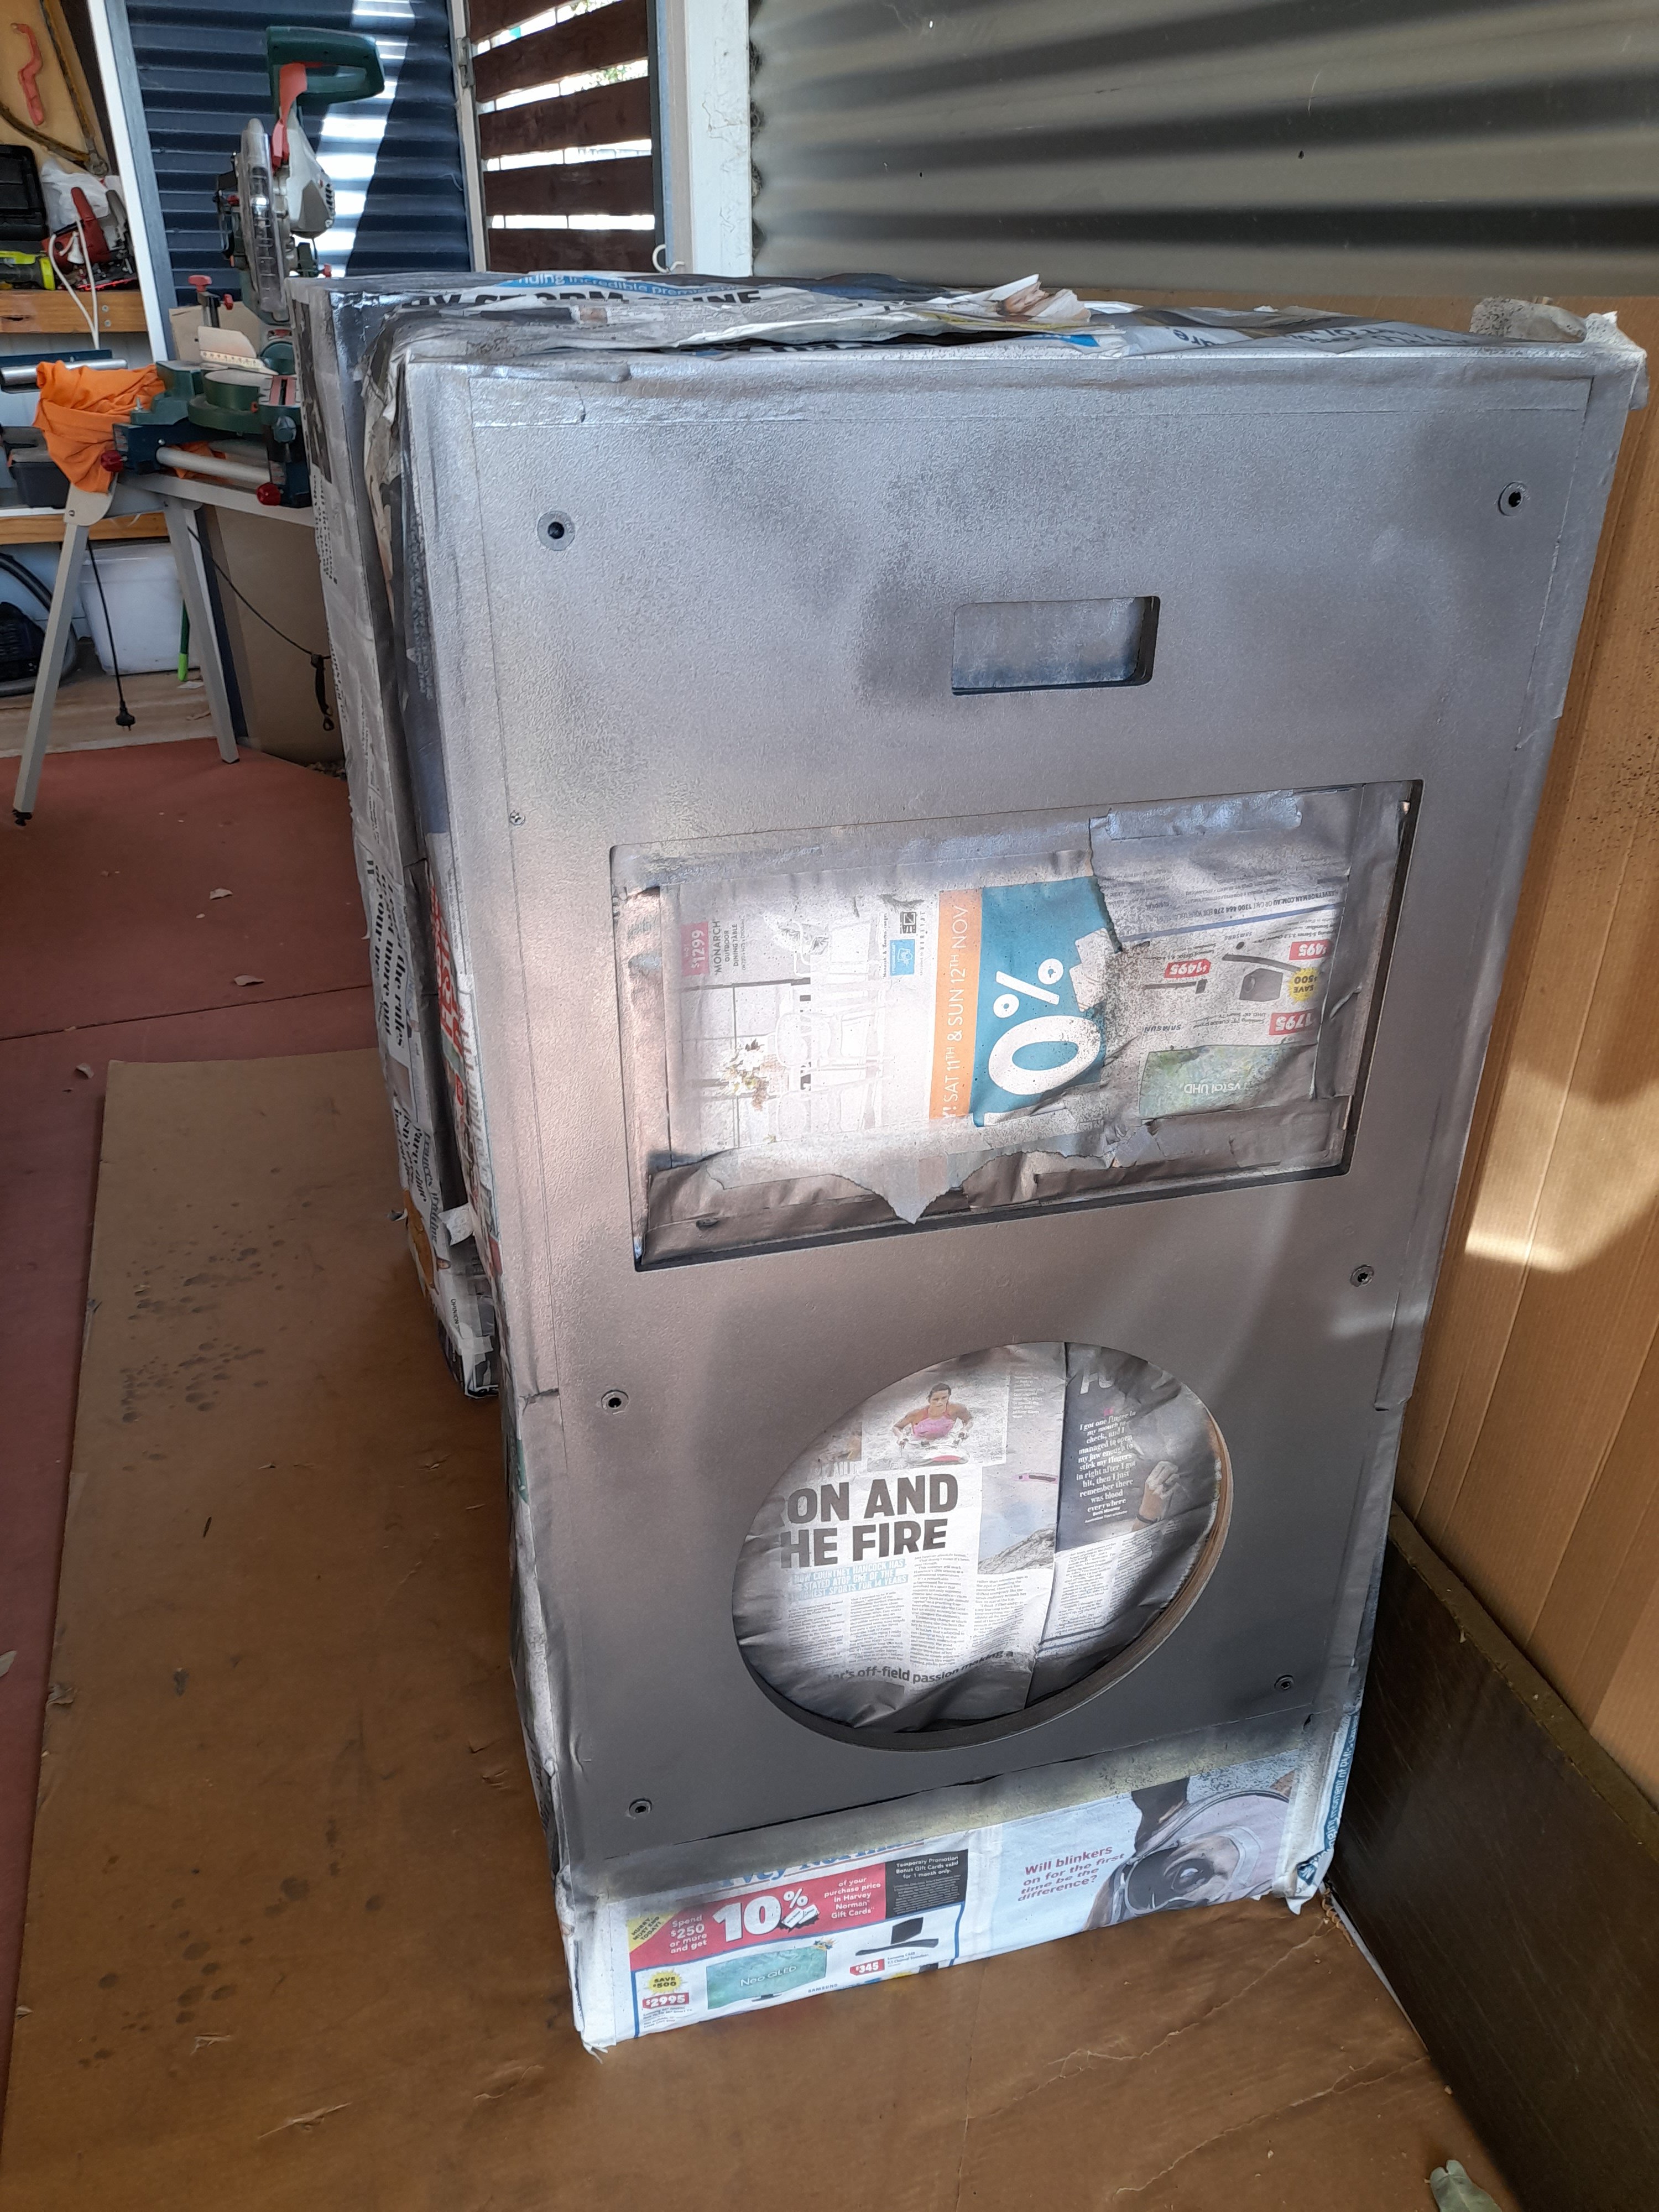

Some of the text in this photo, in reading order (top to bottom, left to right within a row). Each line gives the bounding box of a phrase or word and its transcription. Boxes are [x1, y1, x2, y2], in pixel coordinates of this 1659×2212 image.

[952, 905, 968, 950] NOV
[691, 930, 705, 969] $1299
[1293, 984, 1314, 993] SAVE
[948, 989, 965, 1027] SUN
[947, 1031, 963, 1042] &
[943, 1074, 959, 1102] SAT
[1183, 1083, 1209, 1094] UHD
[1083, 1422, 1094, 1431] got
[1095, 1418, 1107, 1427] one
[1098, 1422, 1118, 1432] mouth
[1108, 1428, 1120, 1438] and
[1078, 1441, 1108, 1455] managed
[1117, 1434, 1133, 1444] open
[1089, 1453, 1101, 1462] jaw
[1102, 1446, 1125, 1457] enough
[1079, 1462, 1096, 1472] stick
[1108, 1453, 1132, 1464] fingers
[1084, 1468, 1102, 1479] right
[1102, 1464, 1120, 1474] after
[1125, 1460, 1136, 1469] got
[1096, 1476, 1111, 1485] then
[1117, 1471, 1130, 1482] just
[1079, 1479, 1134, 1498] remember there
[1091, 1489, 1124, 1504] was blood
[781, 1473, 958, 1530] ON AND
[1087, 1498, 1126, 1512] everywhere
[852, 1518, 948, 1562] FIRE
[813, 1568, 851, 1580] COURTNEY
[852, 1562, 888, 1574] HANCOCK
[889, 1559, 904, 1568] HAS
[880, 1569, 895, 1577] THE
[830, 1583, 857, 1594] SPORTS
[884, 1575, 907, 1585] YEARS
[857, 1666, 911, 1681] off-field
[912, 1667, 959, 1684] passion
[962, 1650, 1004, 1671] making
[896, 1859, 927, 1868] Temporary
[1025, 1846, 1113, 1875] Will blinkers
[1023, 1853, 1125, 1886] on for the first
[849, 1877, 867, 1887] your
[1018, 1874, 1098, 1902] difference?
[1021, 1867, 1099, 1895] time be the
[824, 1882, 881, 1898] purchase price
[834, 1891, 872, 1903] in Harvey
[672, 1914, 703, 1928] Spend
[712, 1888, 809, 1943] 10%
[831, 1911, 847, 1919] Gift
[670, 1923, 705, 1939] $250
[683, 1933, 707, 1944] more
[670, 1939, 707, 1954] and get
[855, 1961, 879, 1974] $345
[740, 1965, 796, 1987] Neo QLED
[808, 1983, 838, 1993] SAMSUNG
[645, 1994, 686, 2008] $2995
